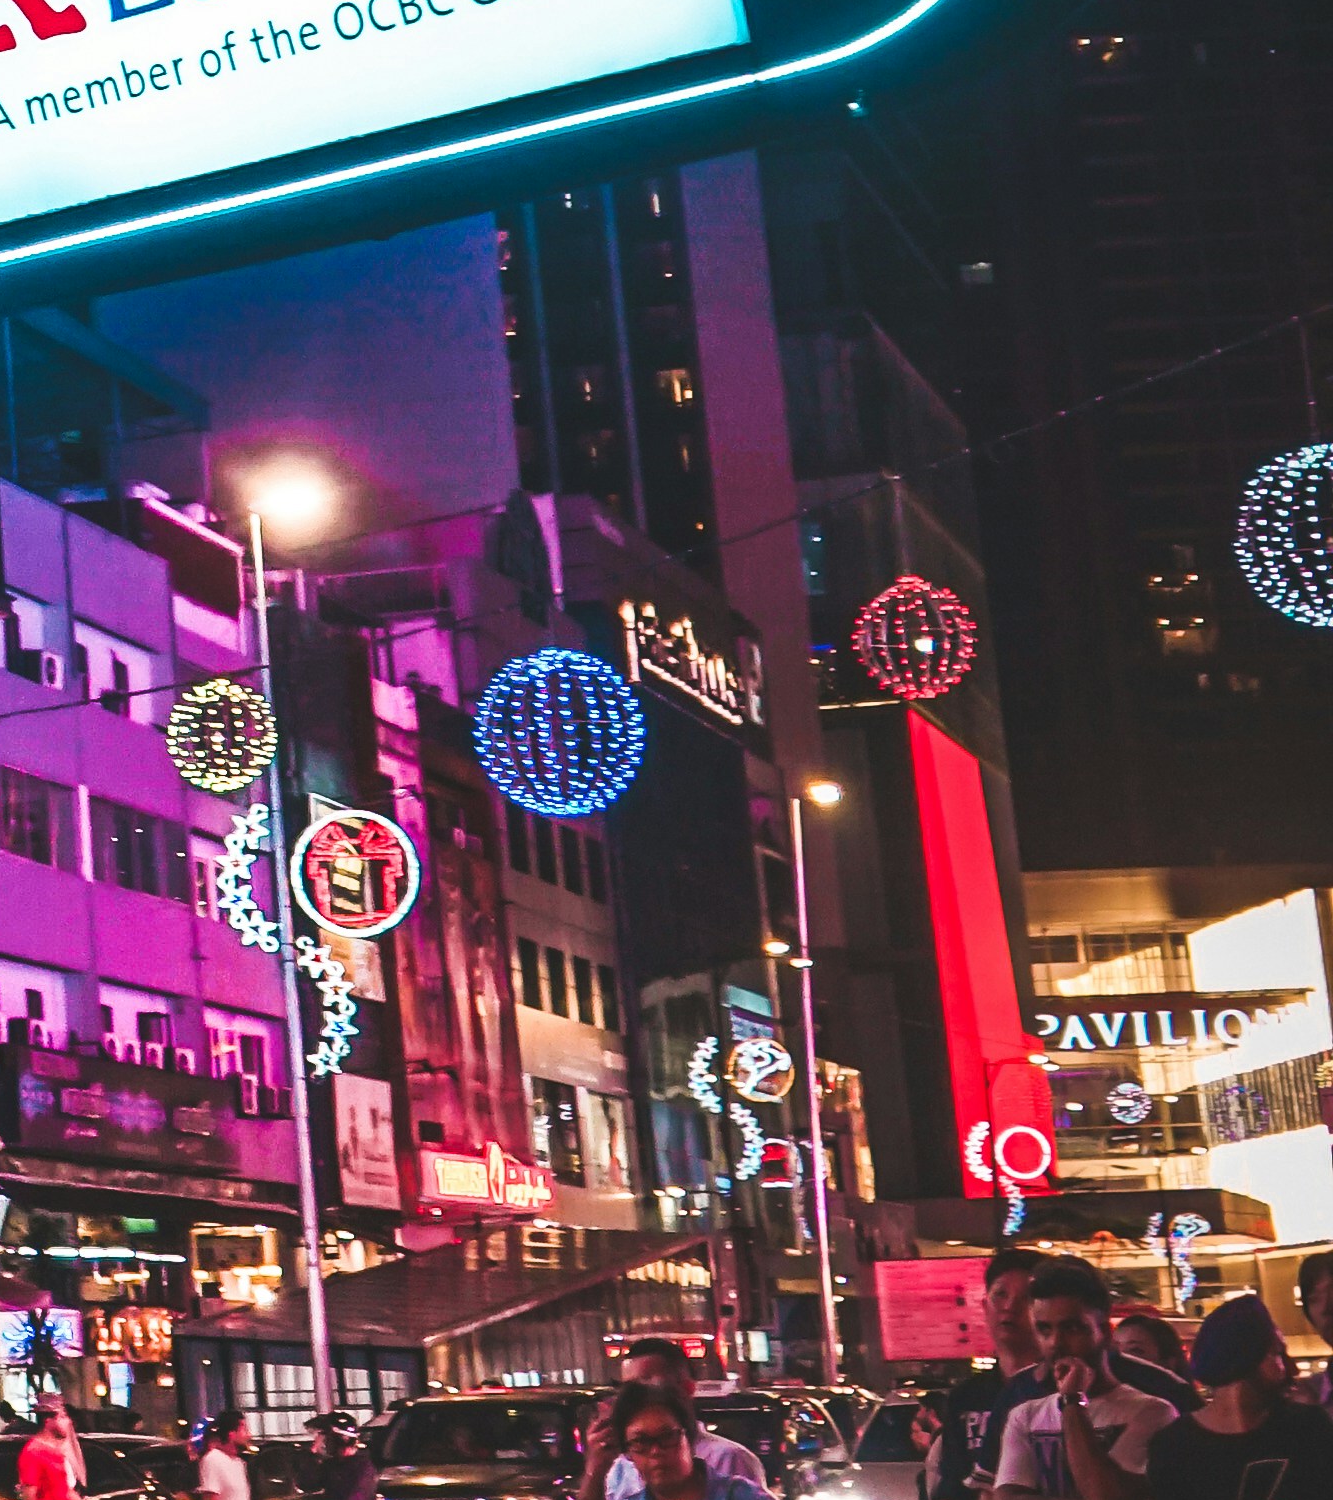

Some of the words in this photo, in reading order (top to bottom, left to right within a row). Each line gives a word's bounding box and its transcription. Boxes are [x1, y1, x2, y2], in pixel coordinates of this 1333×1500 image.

[25, 58, 182, 124] member
[200, 31, 236, 77] of
[250, 21, 321, 63] the
[1035, 1008, 1290, 1050] PAVILIO
